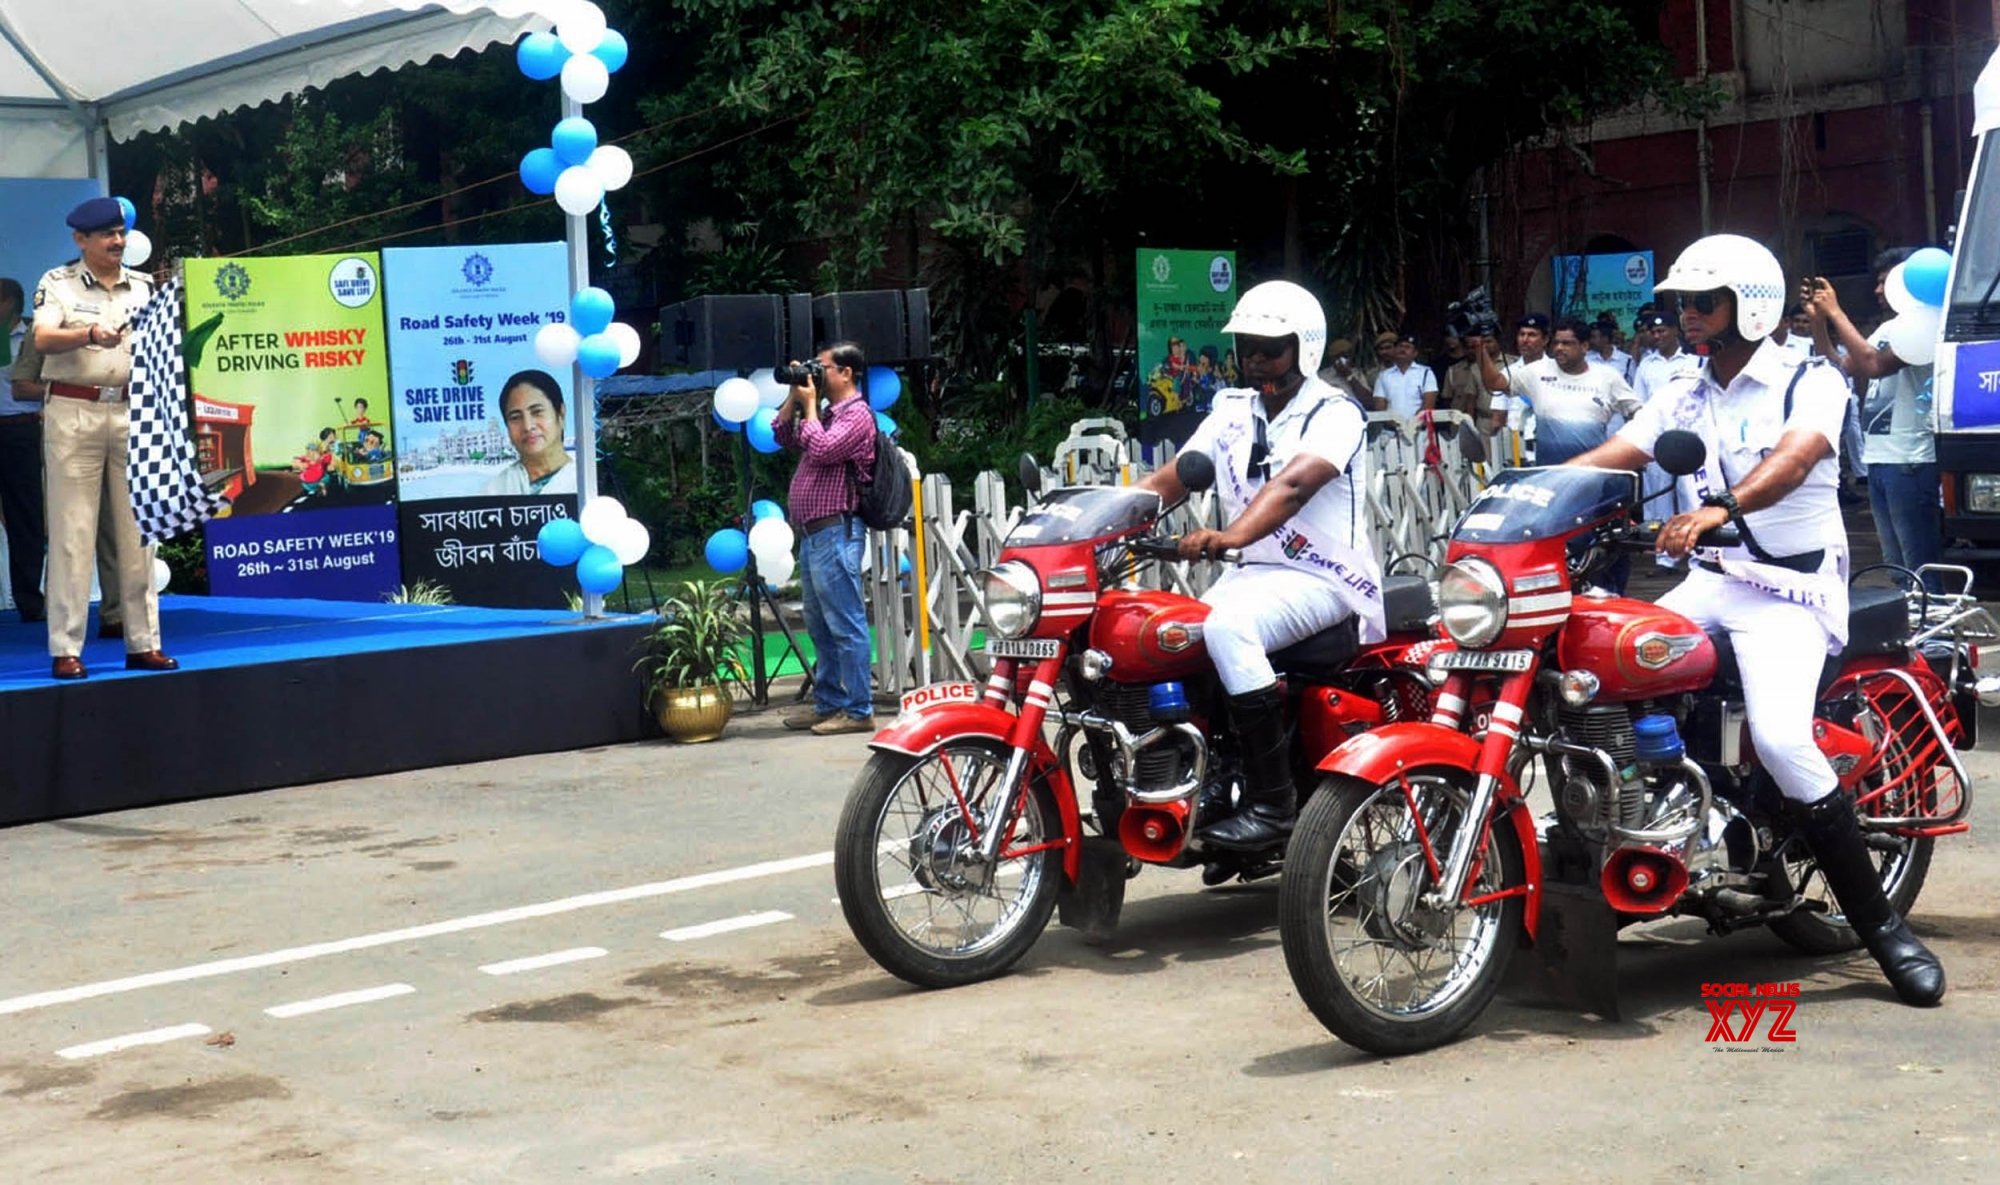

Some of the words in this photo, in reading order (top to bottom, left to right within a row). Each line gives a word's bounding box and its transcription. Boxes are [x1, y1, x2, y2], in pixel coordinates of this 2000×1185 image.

[400, 315, 440, 331] Road
[444, 313, 493, 331] Safety
[497, 311, 540, 327] Week
[216, 333, 279, 351] AFTER
[284, 328, 367, 348] WHISKY
[443, 335, 465, 346] 26th
[494, 333, 527, 346] August
[217, 353, 300, 373] DRIVING
[304, 348, 366, 368] RISKY
[1978, 371, 2000, 394] সা
[405, 387, 440, 406] SAFE
[442, 385, 485, 404] DRIVE
[413, 405, 451, 424] SAVE
[454, 403, 486, 421] LIFE
[418, 506, 504, 533] সাবধানে
[508, 502, 568, 528] চালাও
[212, 542, 260, 560] ROAD
[264, 536, 325, 554] SAFETY
[328, 530, 396, 549] WEEK'19
[434, 538, 496, 569] জীবন
[500, 534, 542, 562] বাঁচা
[237, 561, 271, 578] 26th
[287, 556, 319, 573] 31st
[322, 551, 375, 571] August
[1305, 551, 1348, 576] SAVE
[1343, 571, 1379, 600] LIFE
[902, 684, 976, 711] POLICE
